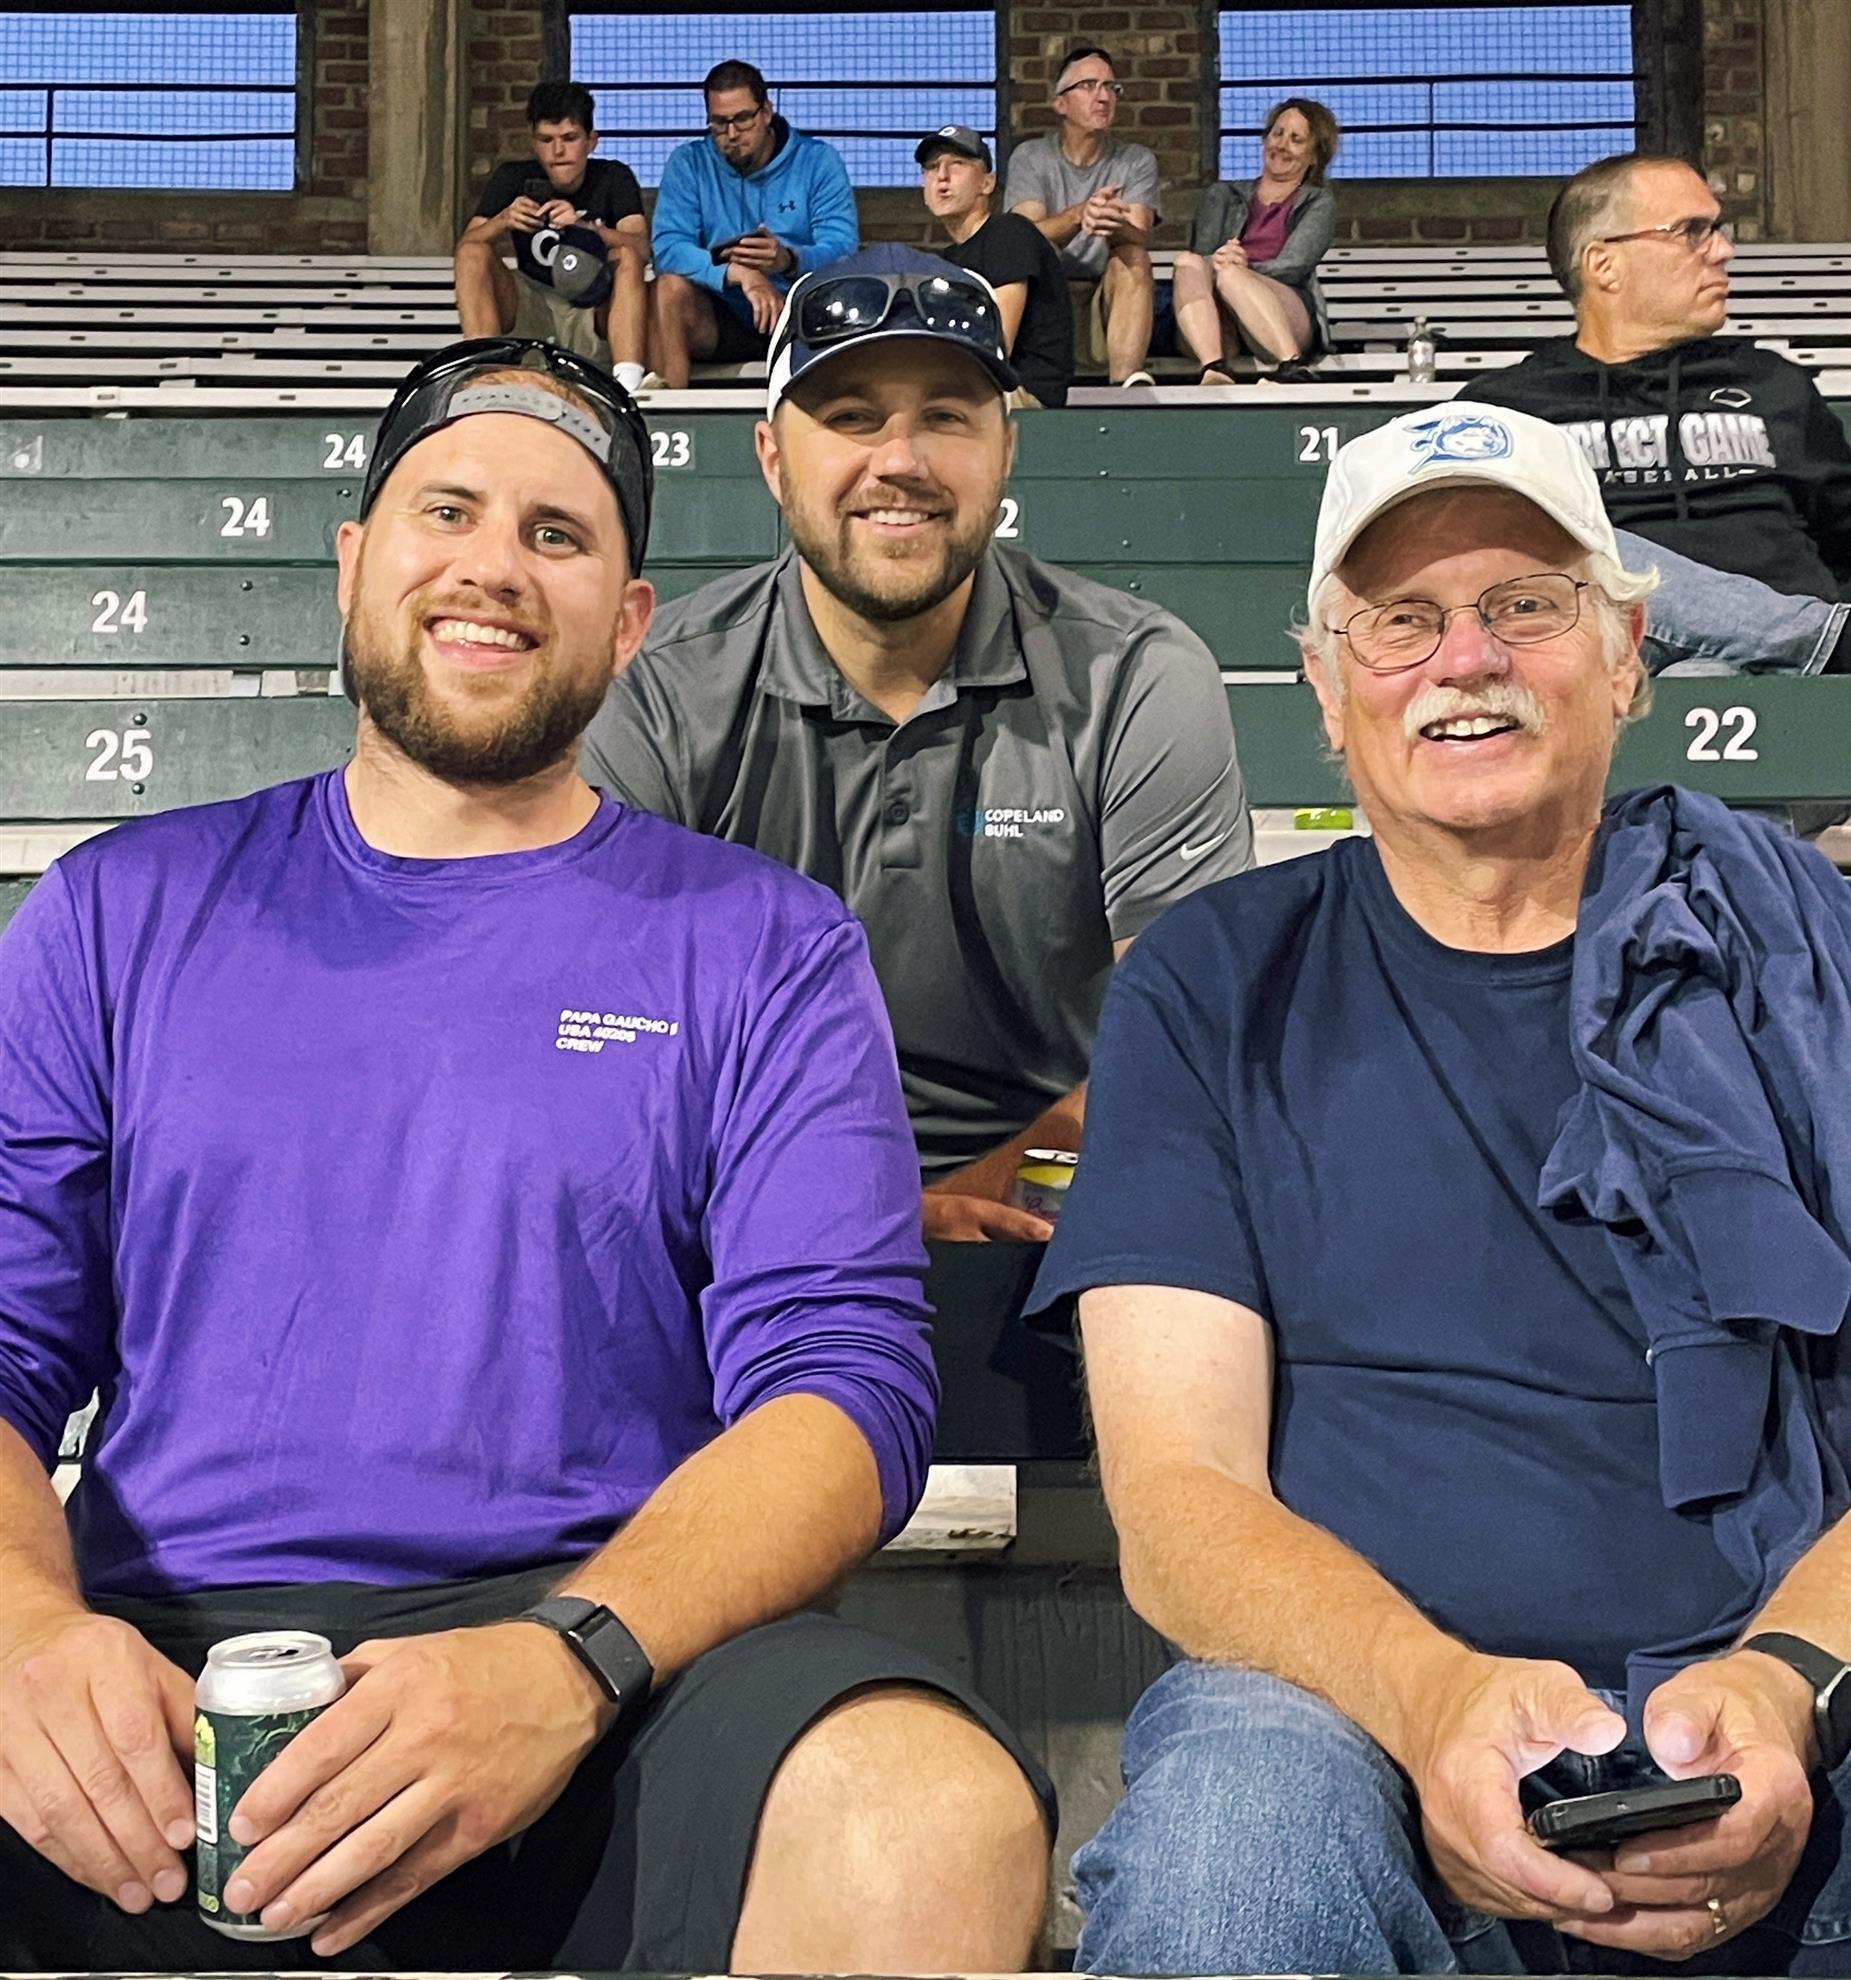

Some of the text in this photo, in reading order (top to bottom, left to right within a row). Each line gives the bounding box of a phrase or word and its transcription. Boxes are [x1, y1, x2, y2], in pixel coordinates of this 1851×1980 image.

[323, 433, 367, 469] 24
[650, 431, 690, 467] 23
[1299, 426, 1338, 462] 21
[1678, 411, 1776, 469] GAME
[220, 496, 271, 537] 24
[994, 498, 1019, 538] 2
[91, 590, 149, 634] 24
[1684, 705, 1759, 761] 22
[85, 728, 154, 782] 25
[984, 808, 1065, 823] COPELAND
[984, 823, 1024, 838] BUHL
[558, 1023, 591, 1038] USA
[560, 1009, 601, 1025] PAPA
[555, 1037, 604, 1053] CREW
